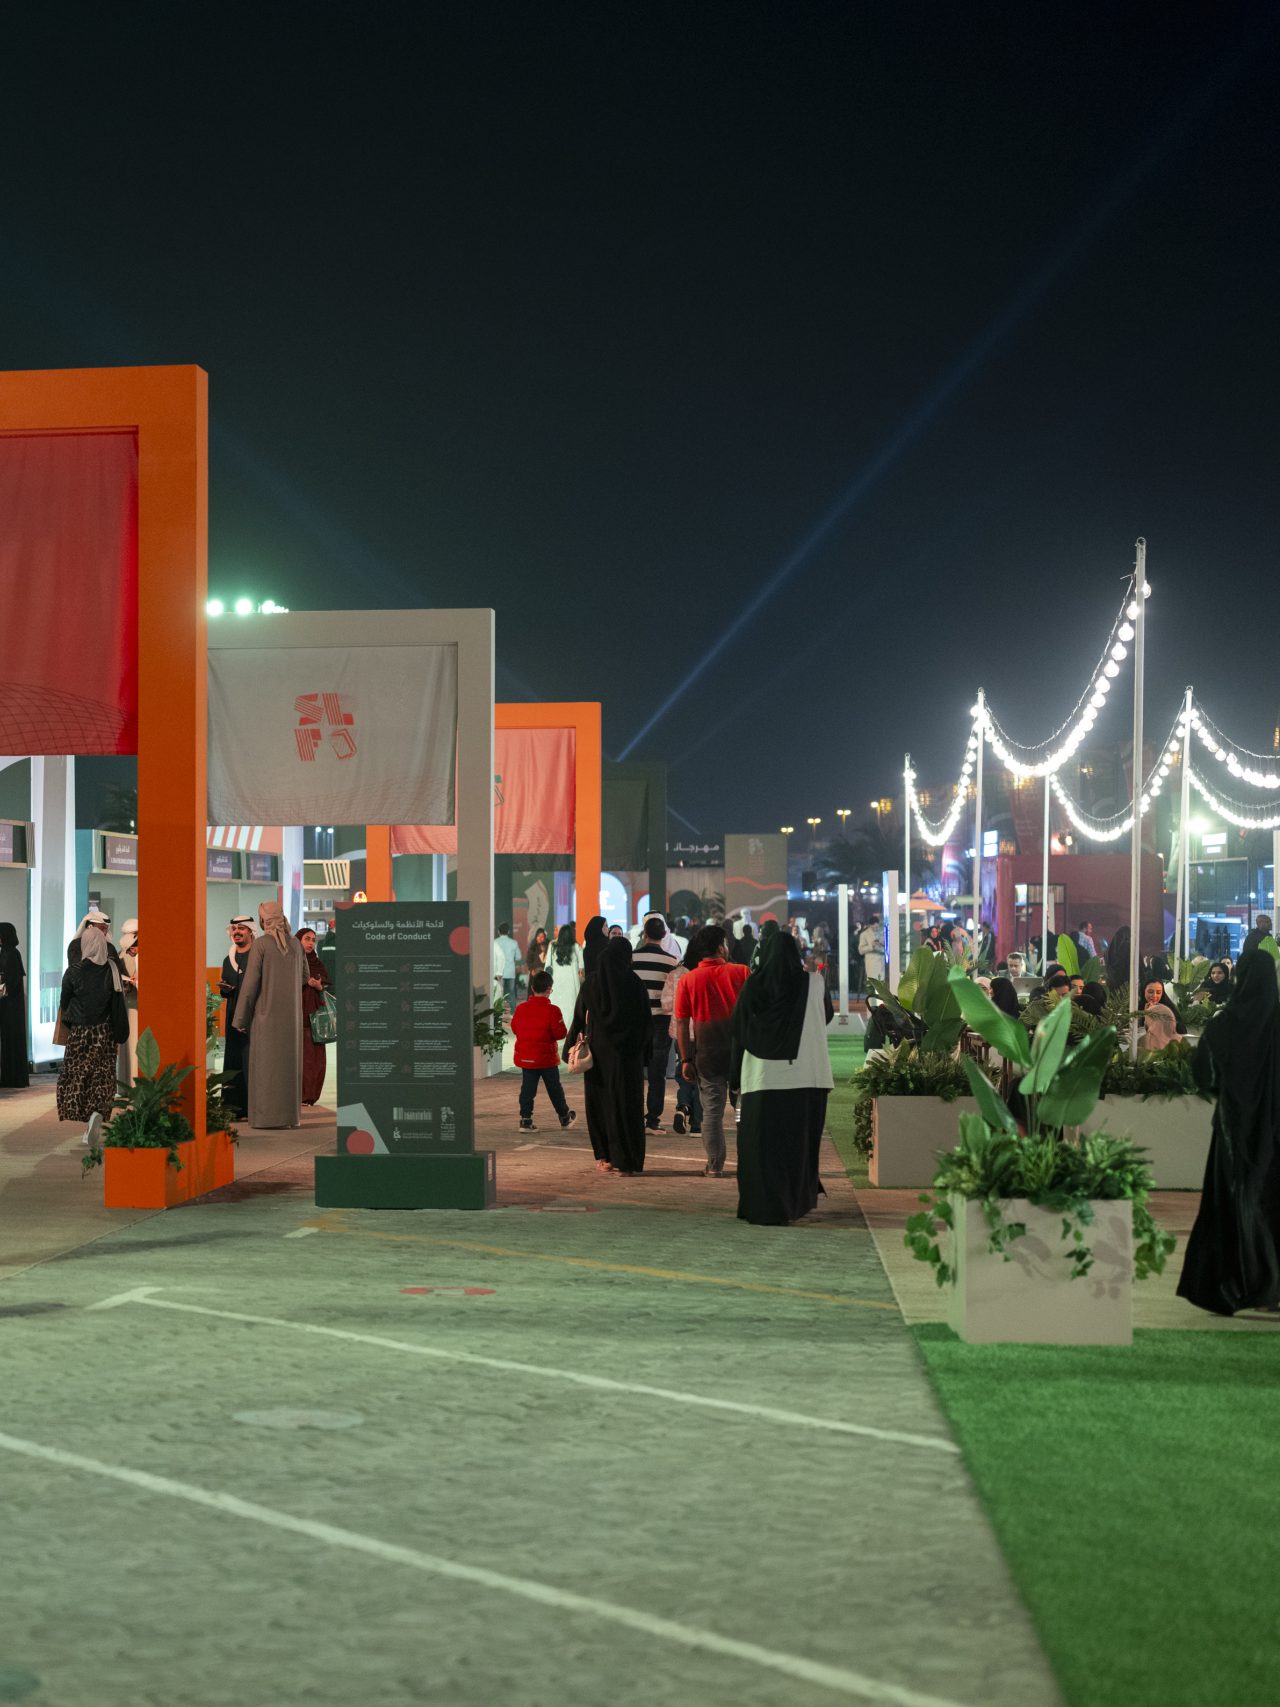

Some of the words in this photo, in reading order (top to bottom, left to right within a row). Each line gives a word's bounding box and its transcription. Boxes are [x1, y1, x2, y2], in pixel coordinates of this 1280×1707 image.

[352, 920, 394, 930] والسلوكيات
[396, 920, 423, 929] الأنظمة
[425, 920, 444, 928] لائحة
[365, 932, 386, 941] Code
[387, 932, 396, 941] of
[397, 932, 432, 941] Conduct
